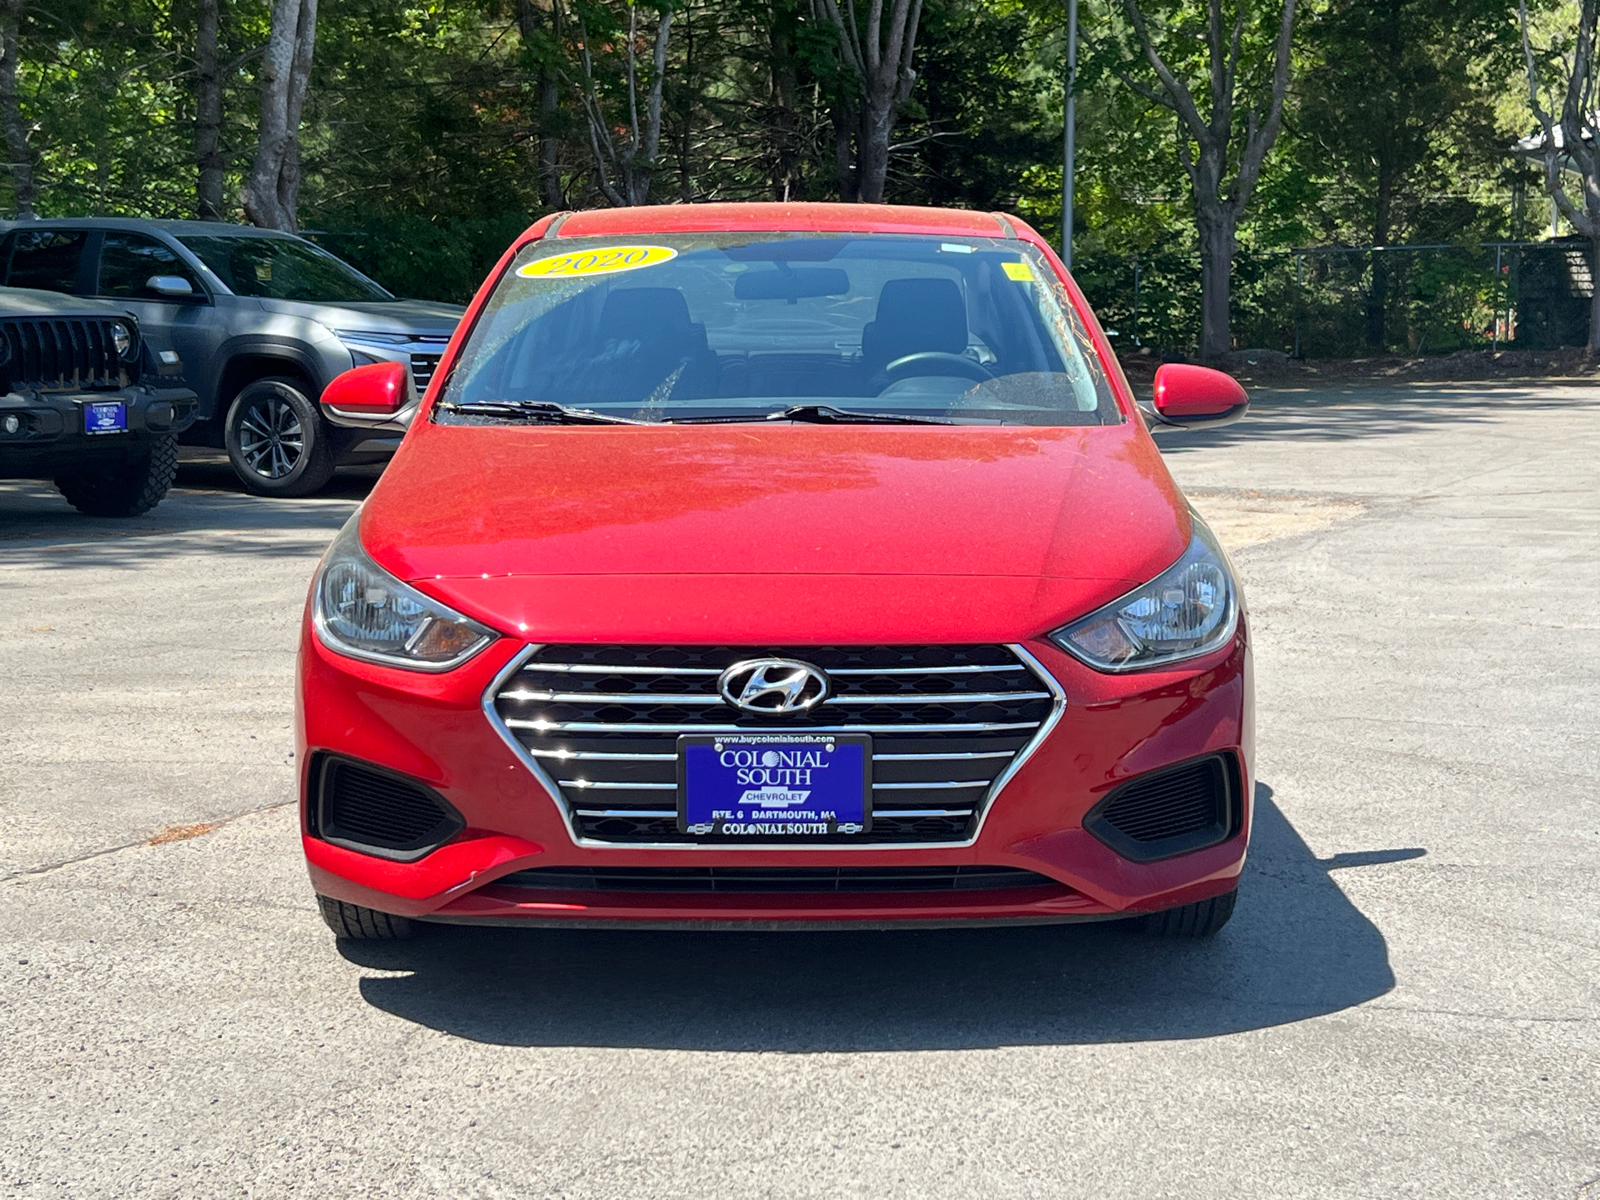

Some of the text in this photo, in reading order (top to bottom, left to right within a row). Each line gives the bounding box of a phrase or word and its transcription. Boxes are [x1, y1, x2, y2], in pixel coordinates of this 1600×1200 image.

[545, 250, 649, 274] 2020
[715, 735, 835, 744] www.buycolonialsouth.com
[720, 750, 829, 768] COLONIAL
[737, 769, 811, 785] SOUTH
[746, 793, 803, 801] CHEVROLET
[737, 811, 743, 819] 6
[752, 811, 818, 820] DARTMOUTH,
[722, 823, 828, 834] COLONIAL SOUTH
